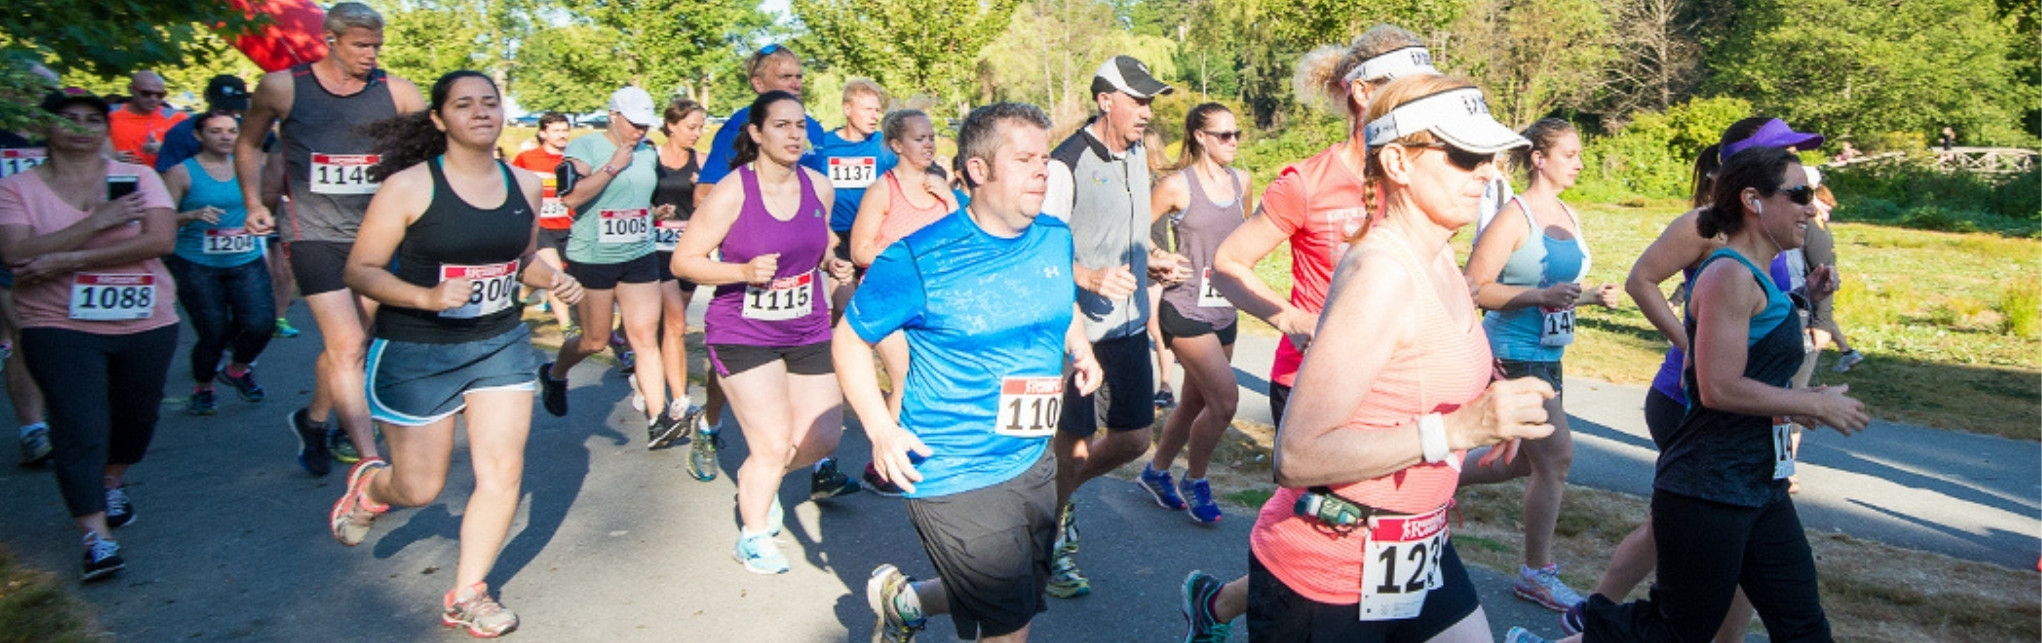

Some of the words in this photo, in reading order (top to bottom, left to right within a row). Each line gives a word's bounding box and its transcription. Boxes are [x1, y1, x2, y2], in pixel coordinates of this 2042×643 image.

[833, 166, 872, 180] 1137
[604, 217, 648, 235] 1008
[208, 234, 253, 250] 1204
[79, 286, 152, 309] 1088
[470, 275, 513, 305] 300
[751, 286, 809, 310] 1115
[1006, 396, 1061, 430] 110
